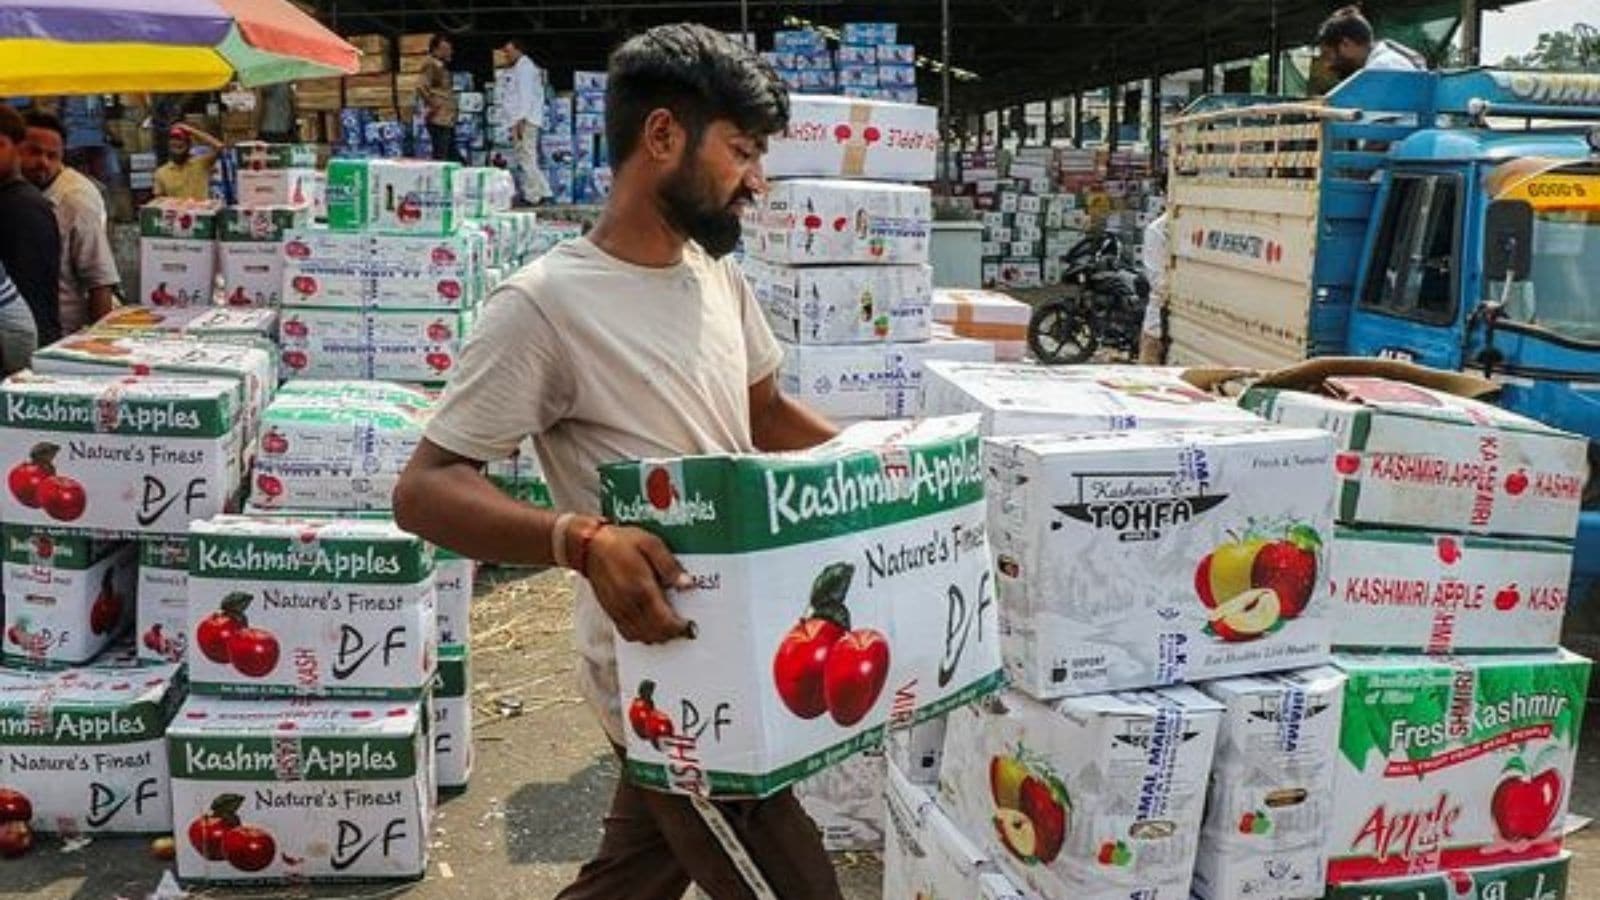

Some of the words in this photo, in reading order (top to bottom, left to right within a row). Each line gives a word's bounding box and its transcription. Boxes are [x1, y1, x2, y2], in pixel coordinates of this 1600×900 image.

[117, 401, 200, 433] Apples
[69, 440, 145, 464] Nature's
[151, 445, 204, 467] Finest
[1371, 452, 1449, 485] KASHMIRI
[1090, 501, 1191, 531] TOHFA
[309, 546, 401, 579] Apples
[865, 529, 950, 589] Nature's
[263, 590, 342, 613] Nature's
[348, 593, 404, 615] Finest
[1345, 576, 1430, 608] KASHMIRI
[1431, 579, 1487, 610] APPLE
[55, 710, 145, 741] Apples
[10, 752, 88, 773] Nature's
[94, 750, 150, 773] Finest
[186, 741, 288, 775] Kashm
[304, 745, 397, 776] Apples
[255, 788, 338, 811] Nature's
[344, 790, 402, 811] Finest
